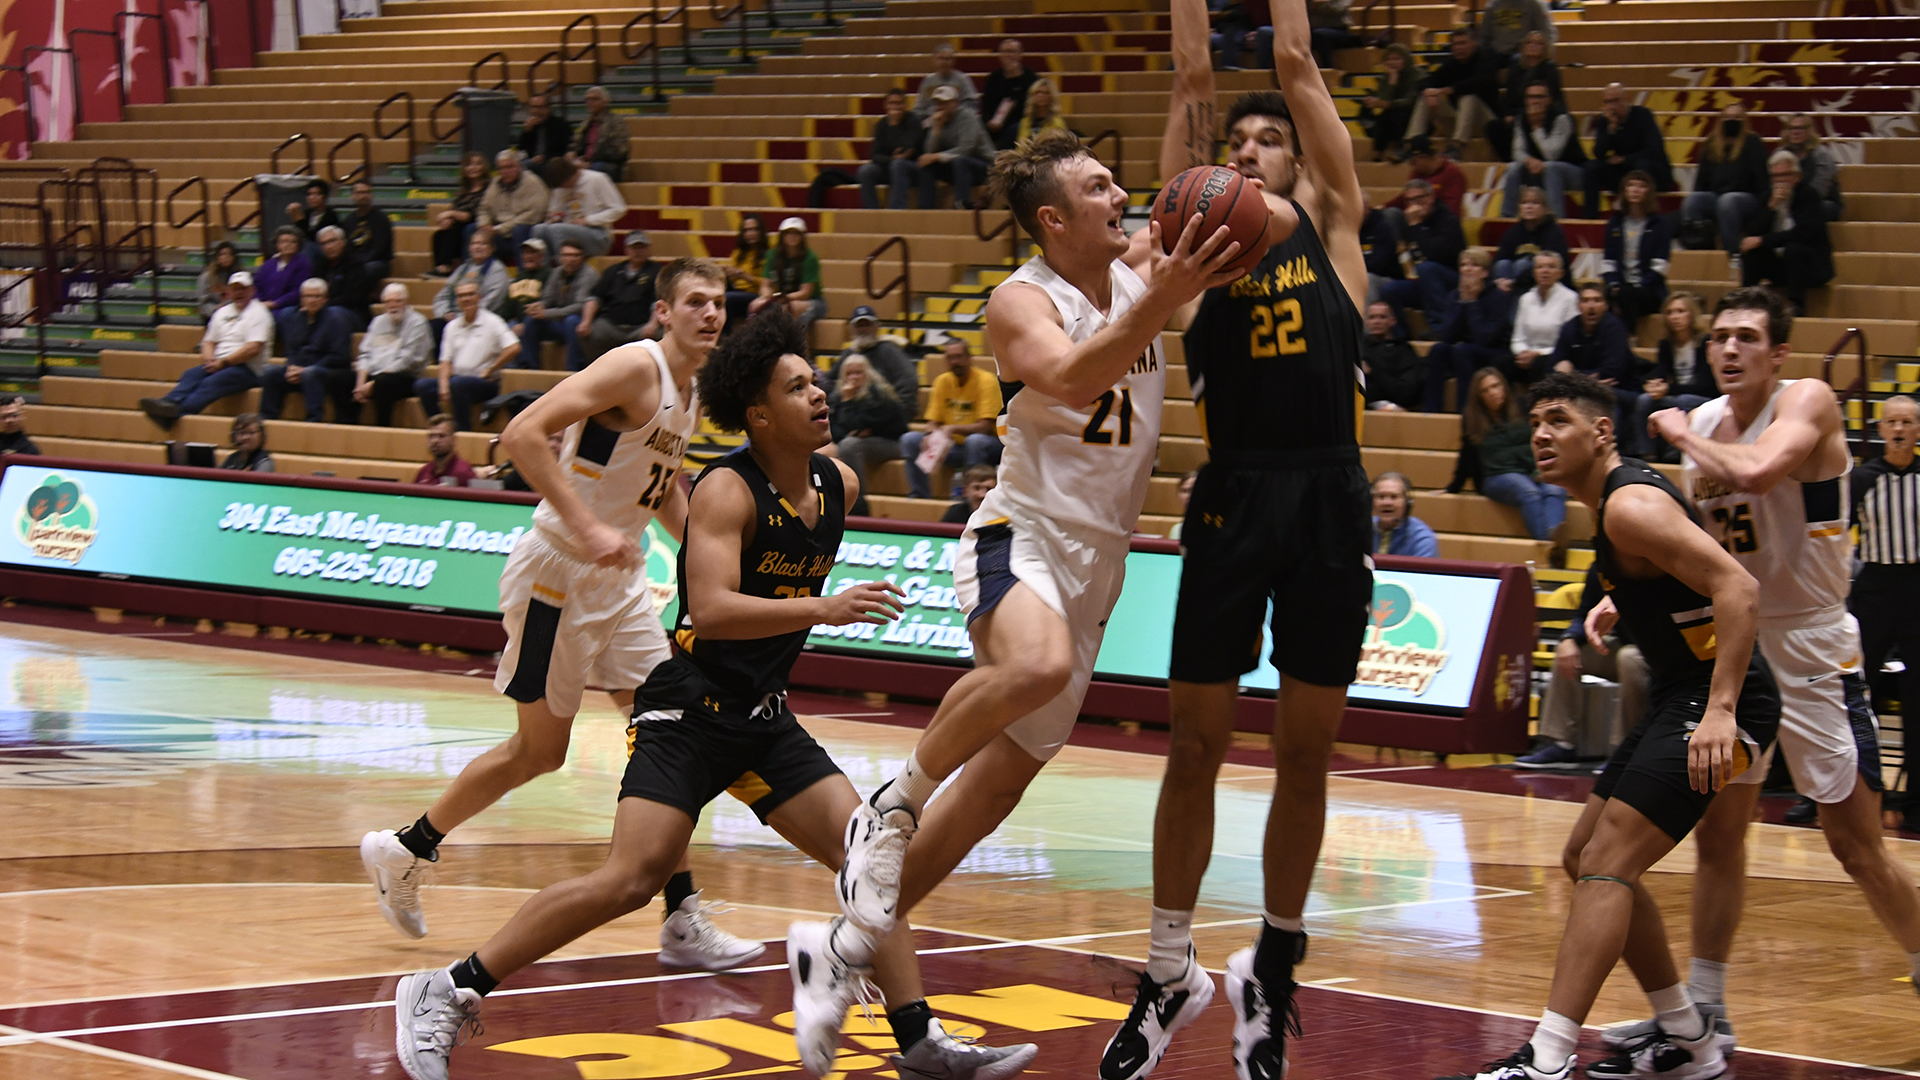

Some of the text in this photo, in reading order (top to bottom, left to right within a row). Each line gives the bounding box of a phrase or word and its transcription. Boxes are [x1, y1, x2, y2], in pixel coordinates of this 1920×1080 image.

[1194, 167, 1236, 226] Wilso
[1250, 298, 1307, 359] 22
[1082, 387, 1134, 447] 21
[636, 461, 675, 511] 25
[218, 502, 525, 553] 304 East Melgaard Road
[273, 547, 438, 588] 605-225-7818
[756, 550, 808, 577] Black
[834, 541, 903, 568] ouse
[903, 539, 935, 570] &
